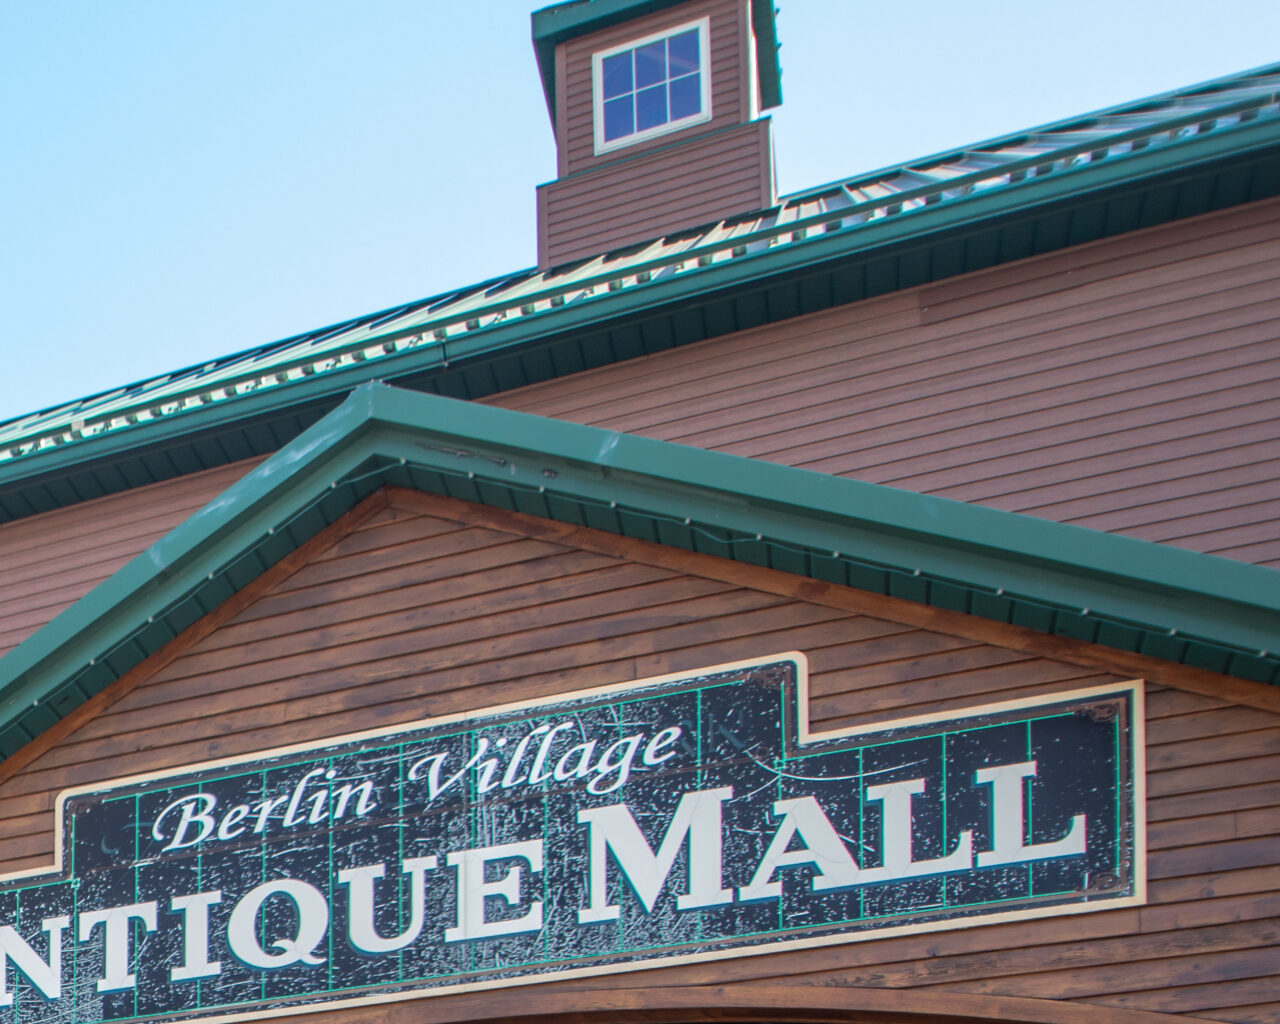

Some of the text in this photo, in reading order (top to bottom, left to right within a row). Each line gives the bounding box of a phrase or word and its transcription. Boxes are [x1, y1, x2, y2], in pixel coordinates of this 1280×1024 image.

[153, 768, 378, 852] Berlin
[408, 721, 682, 796] Village
[577, 760, 1088, 926] MALL
